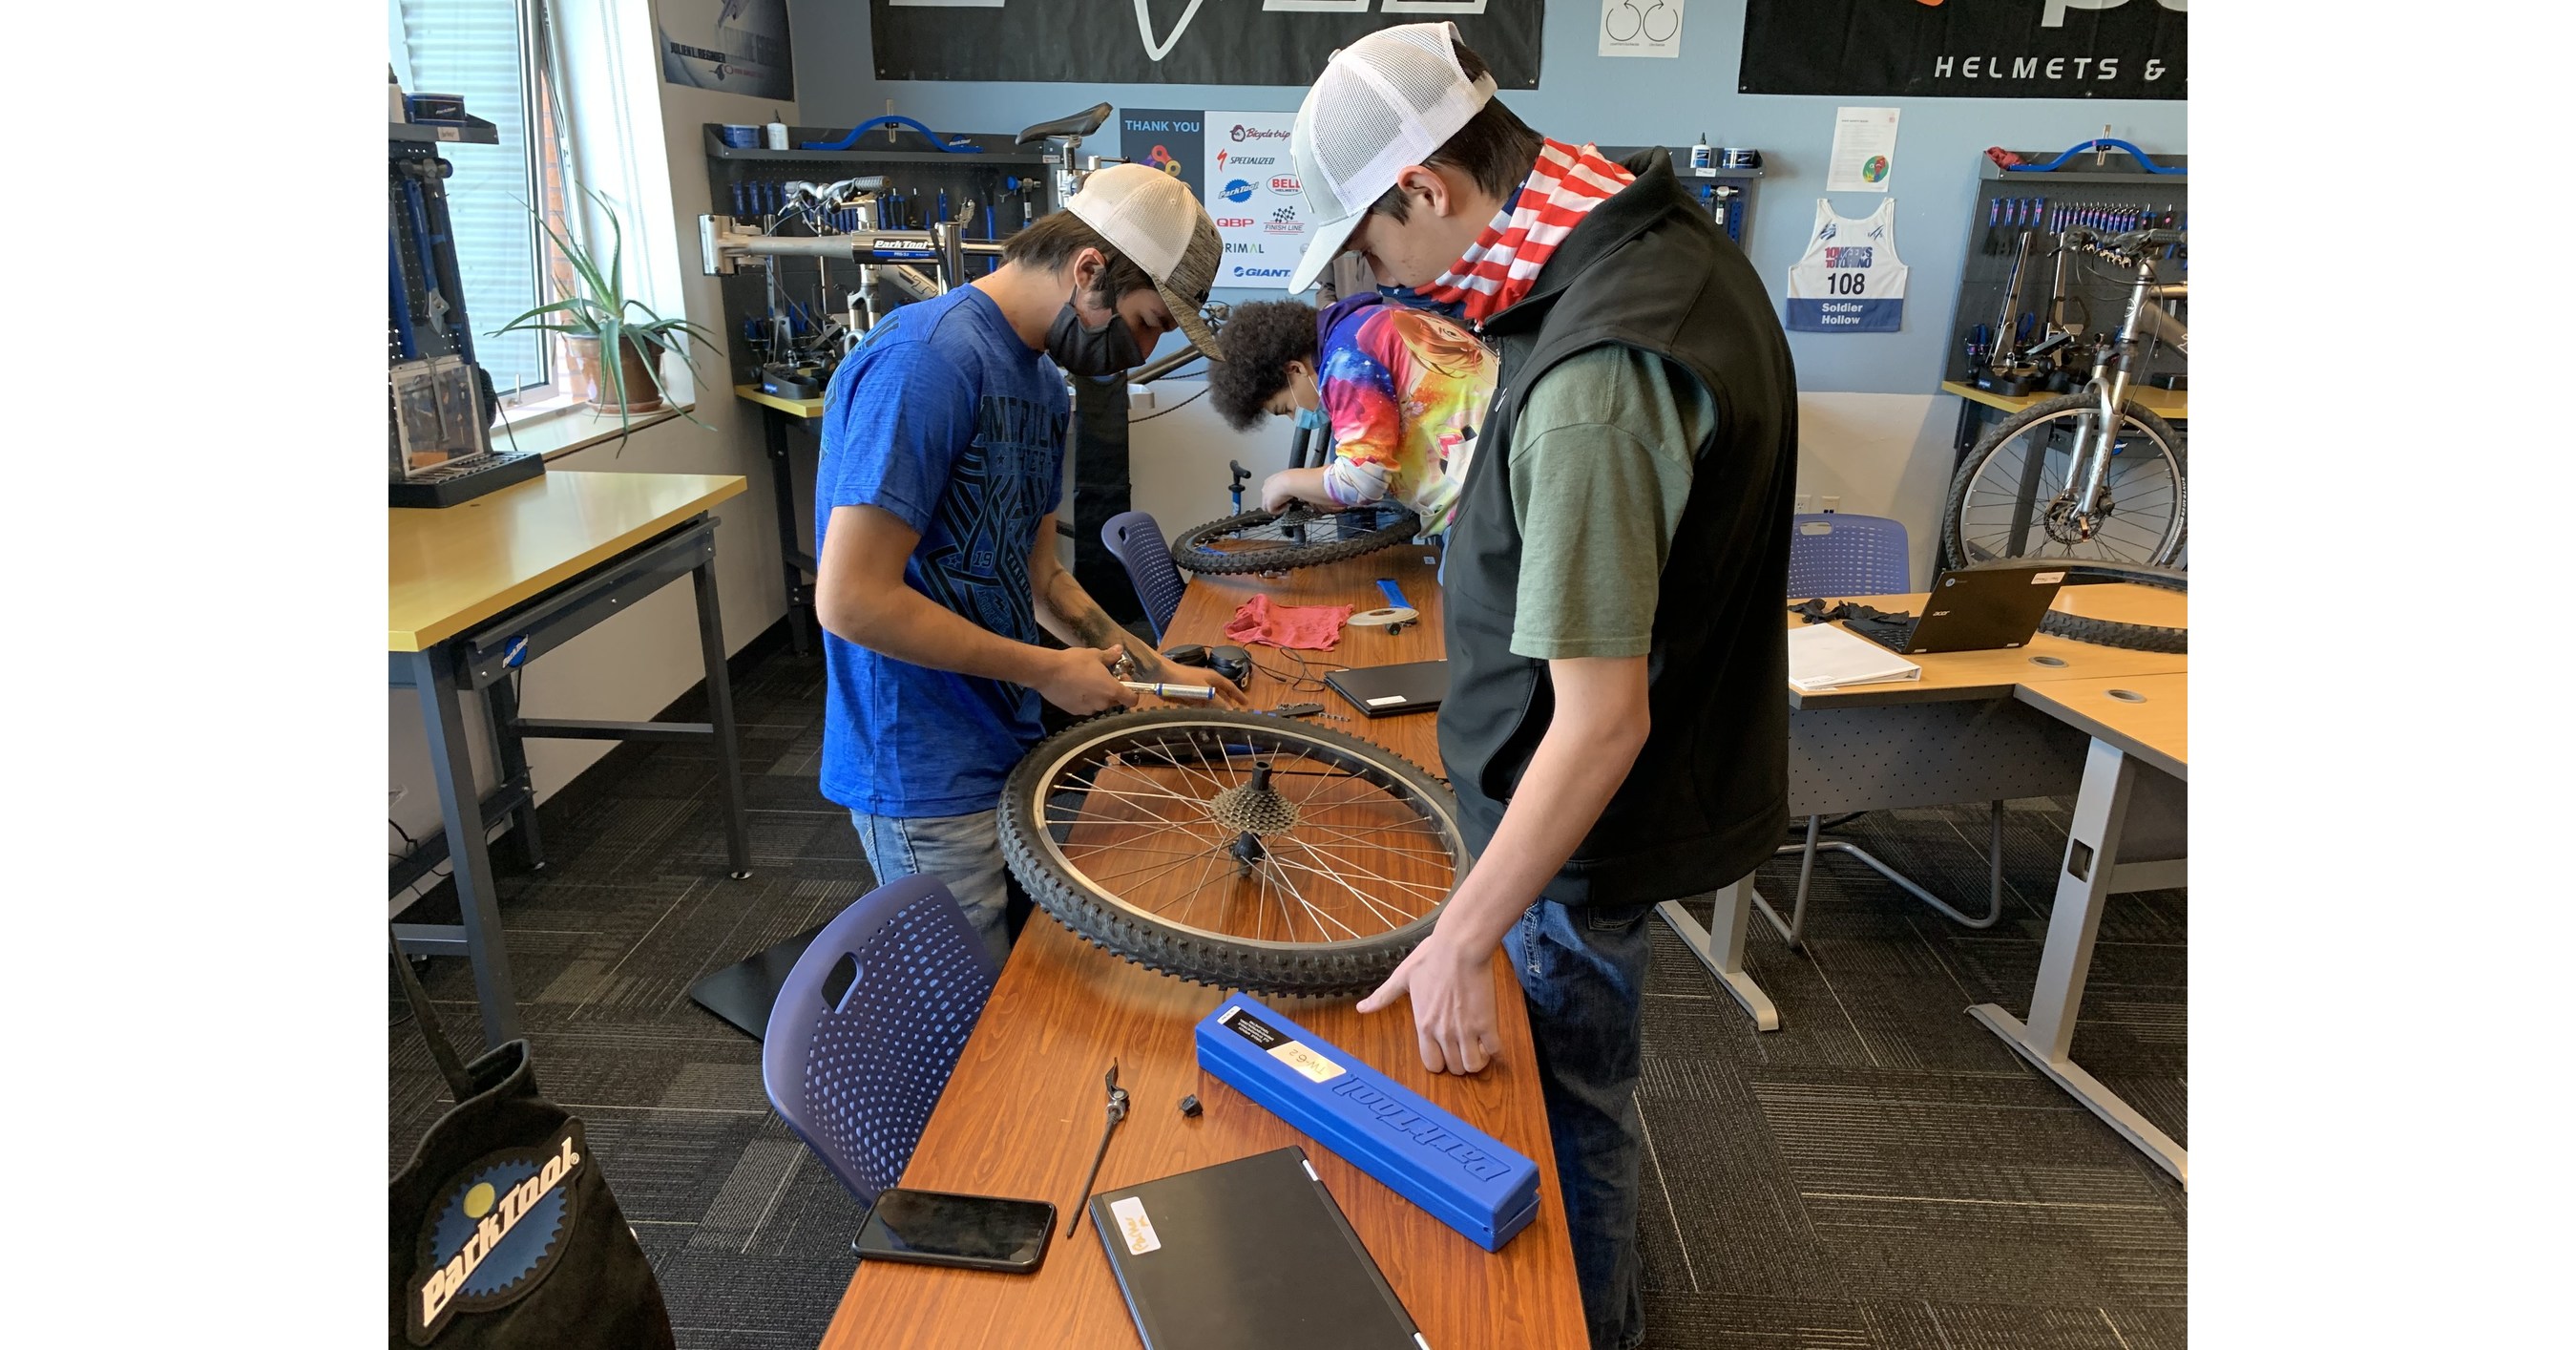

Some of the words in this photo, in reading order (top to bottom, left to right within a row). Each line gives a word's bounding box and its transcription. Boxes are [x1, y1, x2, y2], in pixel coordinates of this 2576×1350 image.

[1934, 55, 2119, 80] HELMETS
[2144, 58, 2166, 81] &
[1124, 119, 1169, 132] THANK
[1172, 121, 1200, 133] YOU
[1246, 128, 1273, 141] Bicycle
[1273, 129, 1290, 141] trip
[1229, 156, 1275, 165] SPECIALIZED
[1272, 179, 1300, 188] BELL
[1216, 218, 1254, 227] QBP
[1225, 243, 1265, 254] RIMAL
[1246, 268, 1290, 277] GIANT
[1827, 273, 1865, 295] 108
[1821, 303, 1863, 312] Soldier
[1821, 315, 1860, 325] Hollow
[974, 551, 994, 568] 19
